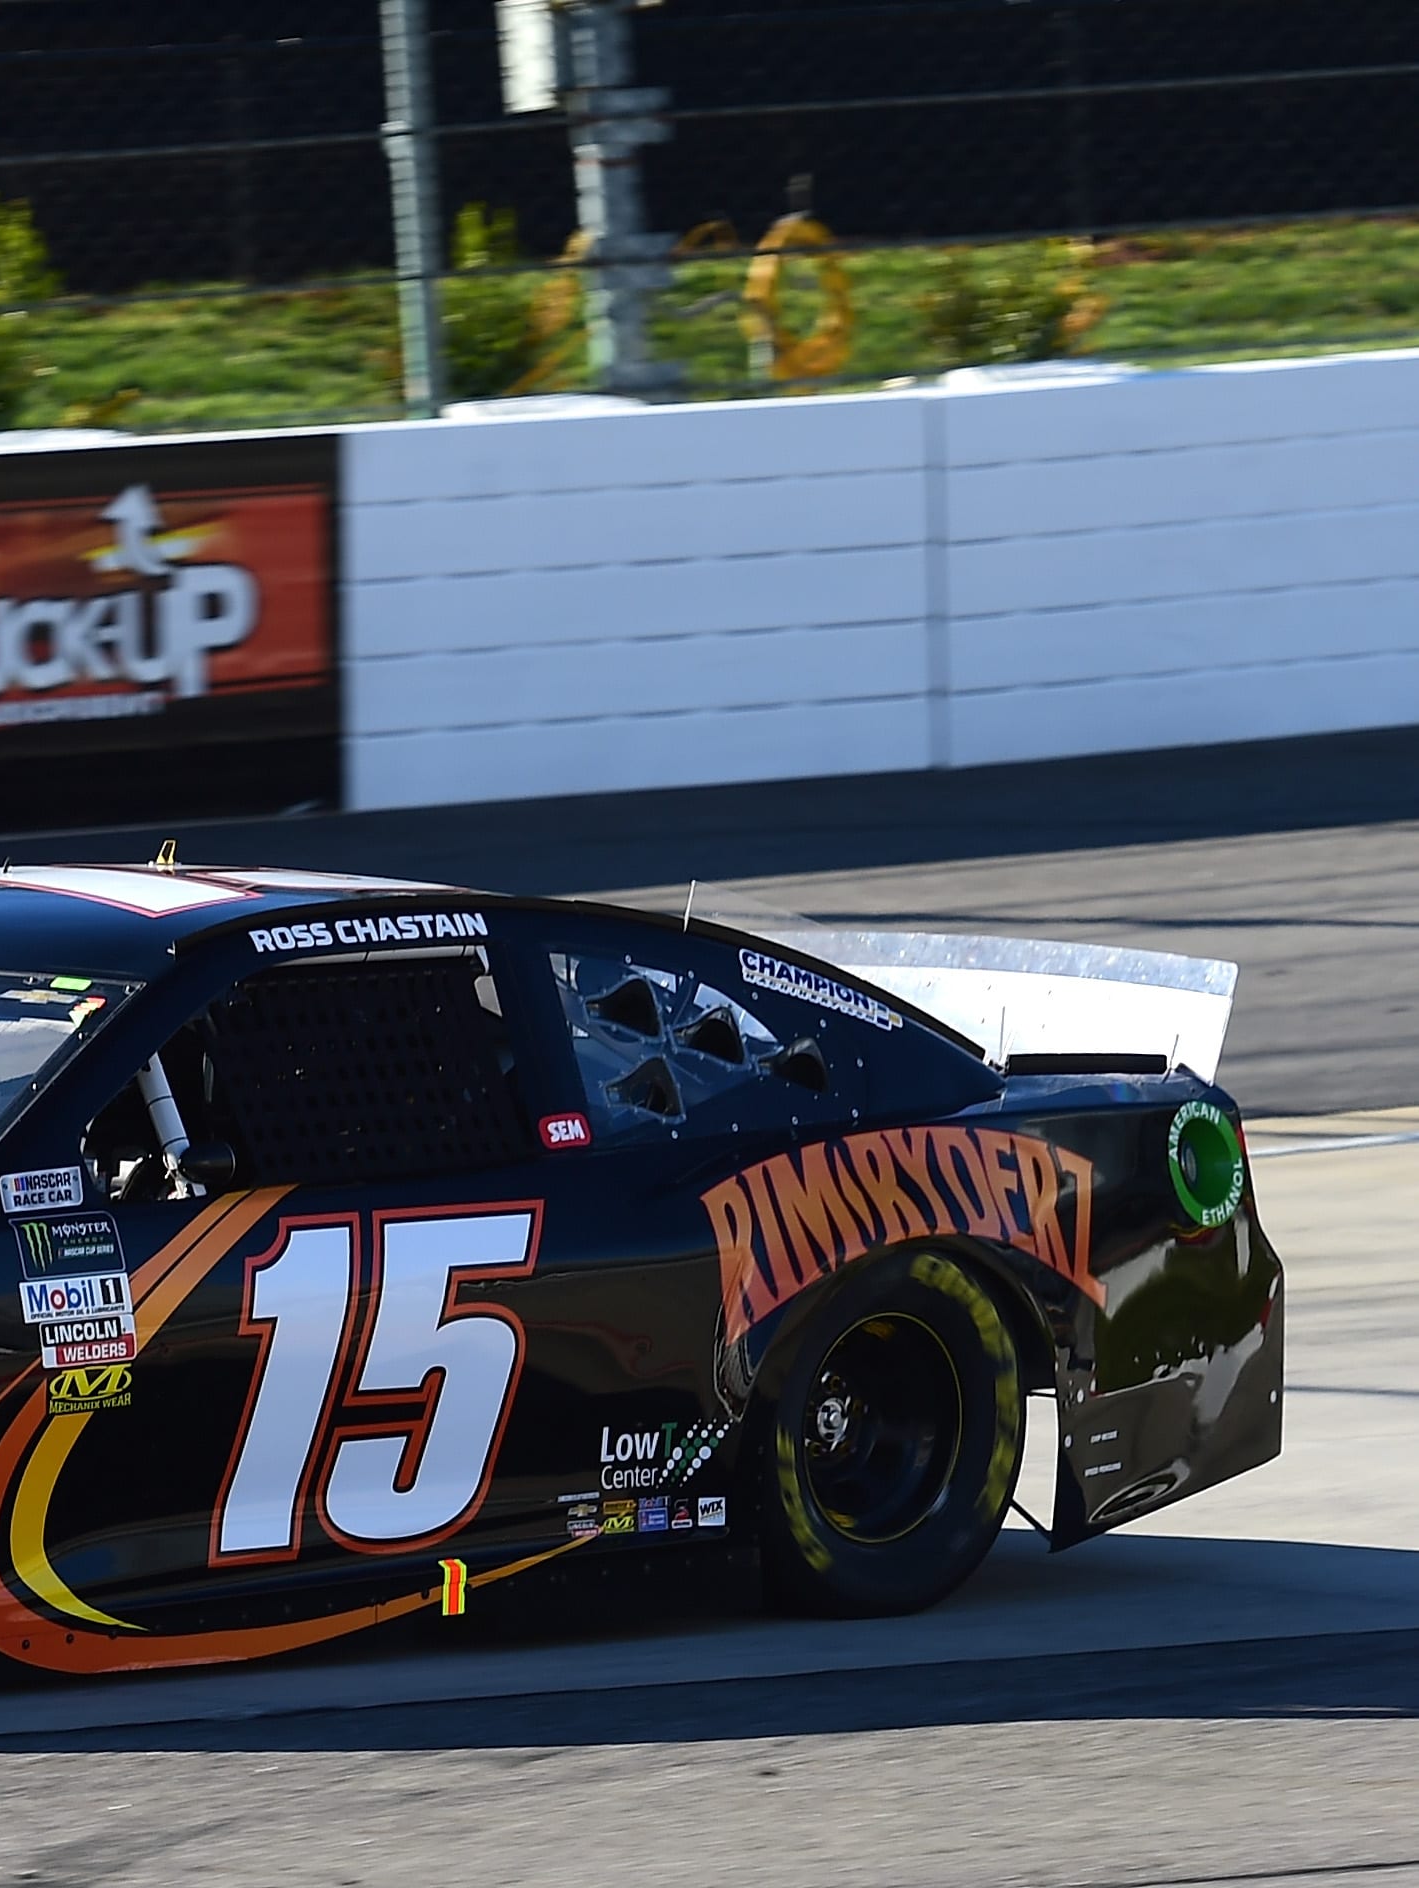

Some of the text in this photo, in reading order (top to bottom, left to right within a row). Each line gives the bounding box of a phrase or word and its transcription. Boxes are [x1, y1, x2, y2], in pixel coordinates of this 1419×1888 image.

[248, 913, 488, 952] ROSS CHASTAIN
[742, 951, 871, 1011] CHAMPION
[547, 1119, 585, 1142] SEM
[1168, 1101, 1220, 1162] AMERICAN
[24, 1172, 71, 1191] NASCAR
[1201, 1157, 1243, 1225] ETHANOL
[14, 1190, 72, 1207] RACE CAR
[26, 1279, 117, 1312] Mobil 1
[44, 1320, 117, 1344] LINCOLN
[63, 1342, 127, 1362] WELDERS
[208, 1199, 545, 1568] 15
[49, 1393, 131, 1414] MECHANIX WEAR
[601, 1465, 658, 1490] Center
[700, 1500, 723, 1515] WIX
